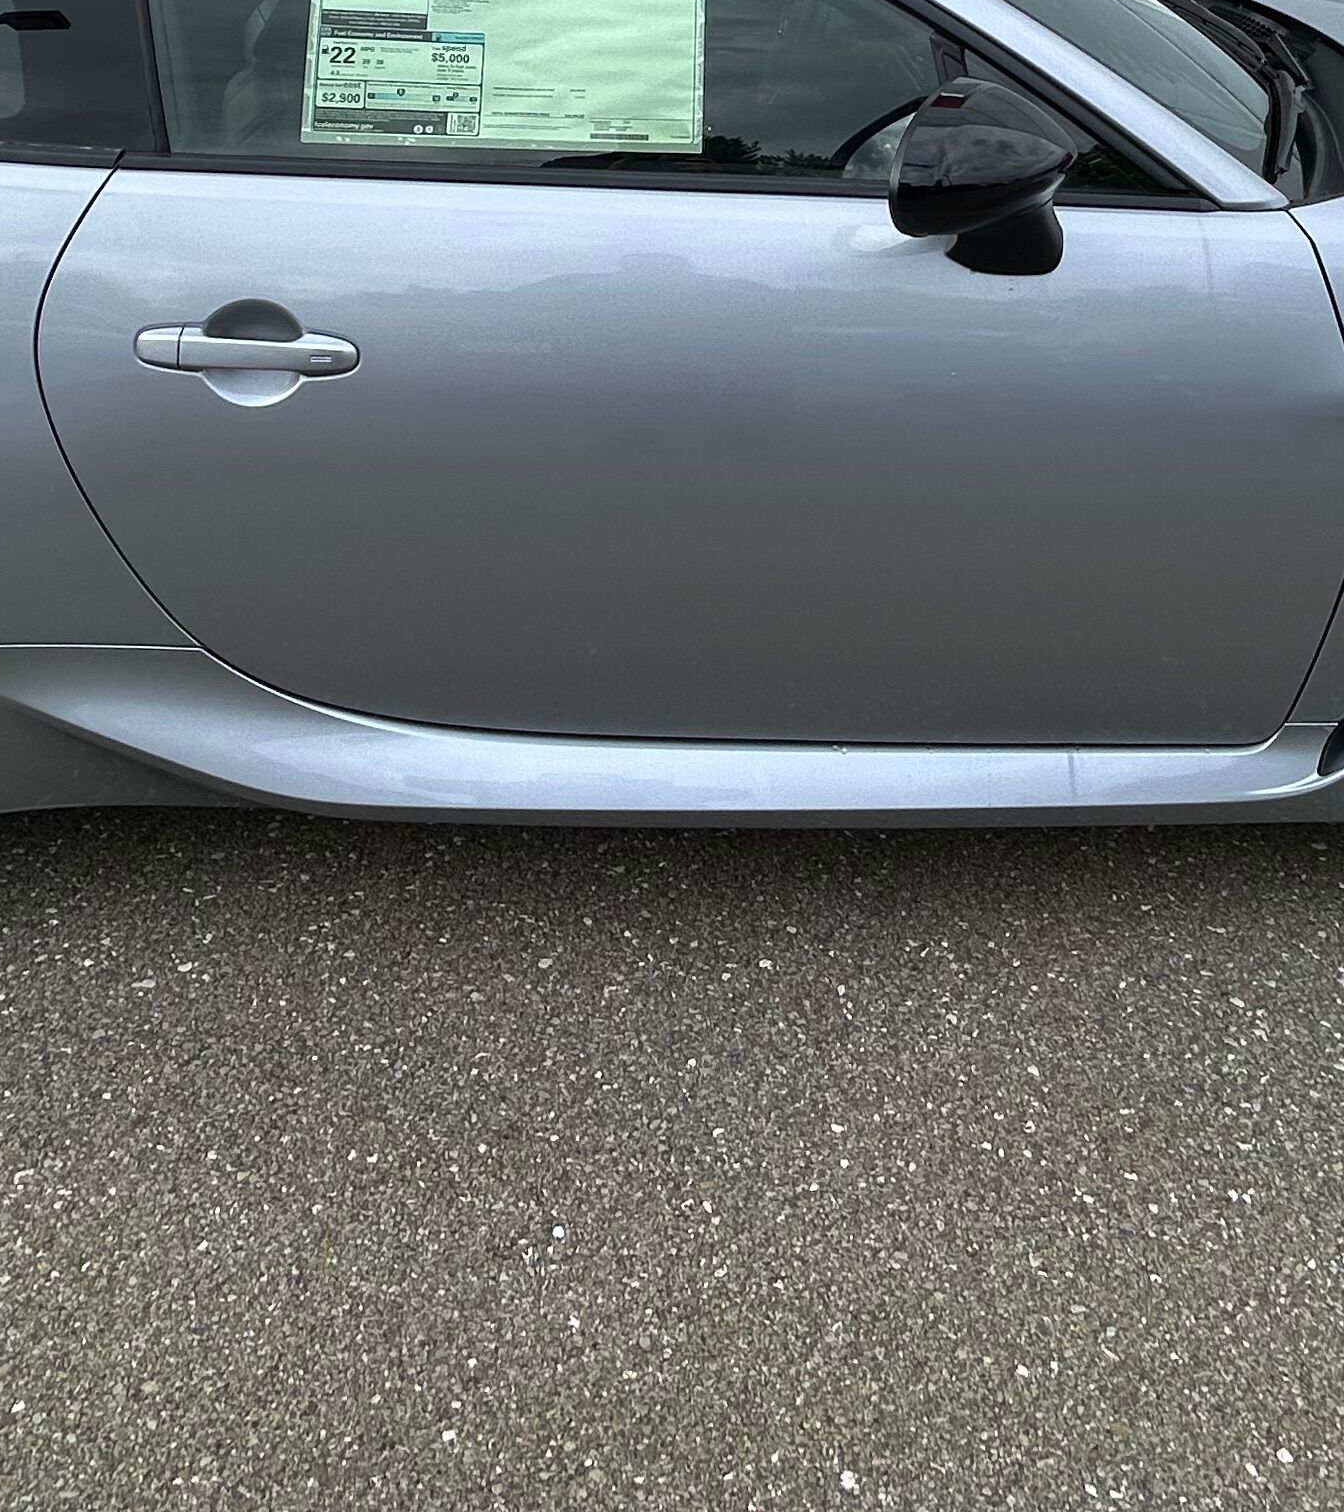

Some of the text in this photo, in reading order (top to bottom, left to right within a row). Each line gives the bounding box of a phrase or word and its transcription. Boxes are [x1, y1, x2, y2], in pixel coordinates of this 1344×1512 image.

[333, 29, 346, 37] Fuel
[347, 30, 374, 38] Economy
[329, 46, 356, 64] 22
[431, 53, 470, 65] $5,000
[321, 92, 361, 104] $2,900
